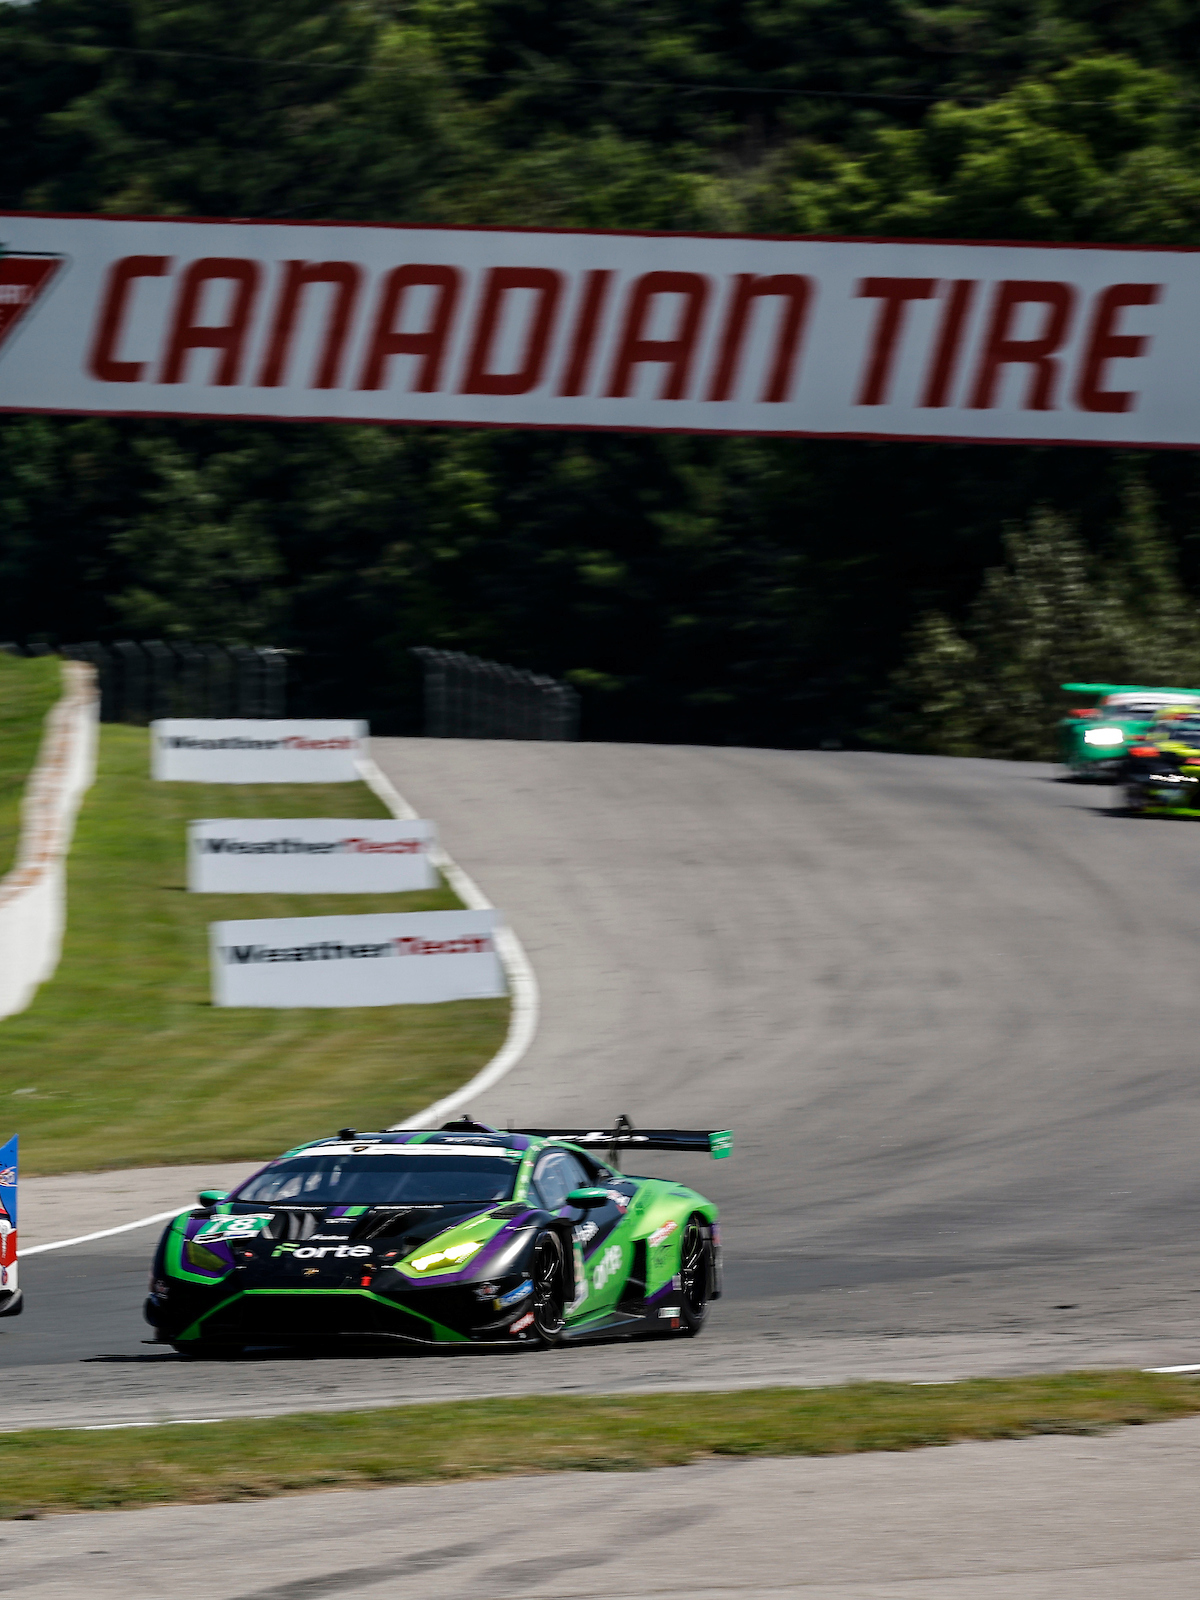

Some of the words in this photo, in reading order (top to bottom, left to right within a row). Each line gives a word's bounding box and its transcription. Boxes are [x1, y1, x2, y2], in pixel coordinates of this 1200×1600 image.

[85, 254, 816, 404] CANADIAN
[854, 275, 1164, 413] TIRE
[196, 837, 432, 854] WeatherTech
[218, 934, 493, 965] WeatherTech
[271, 1242, 373, 1259] Forte
